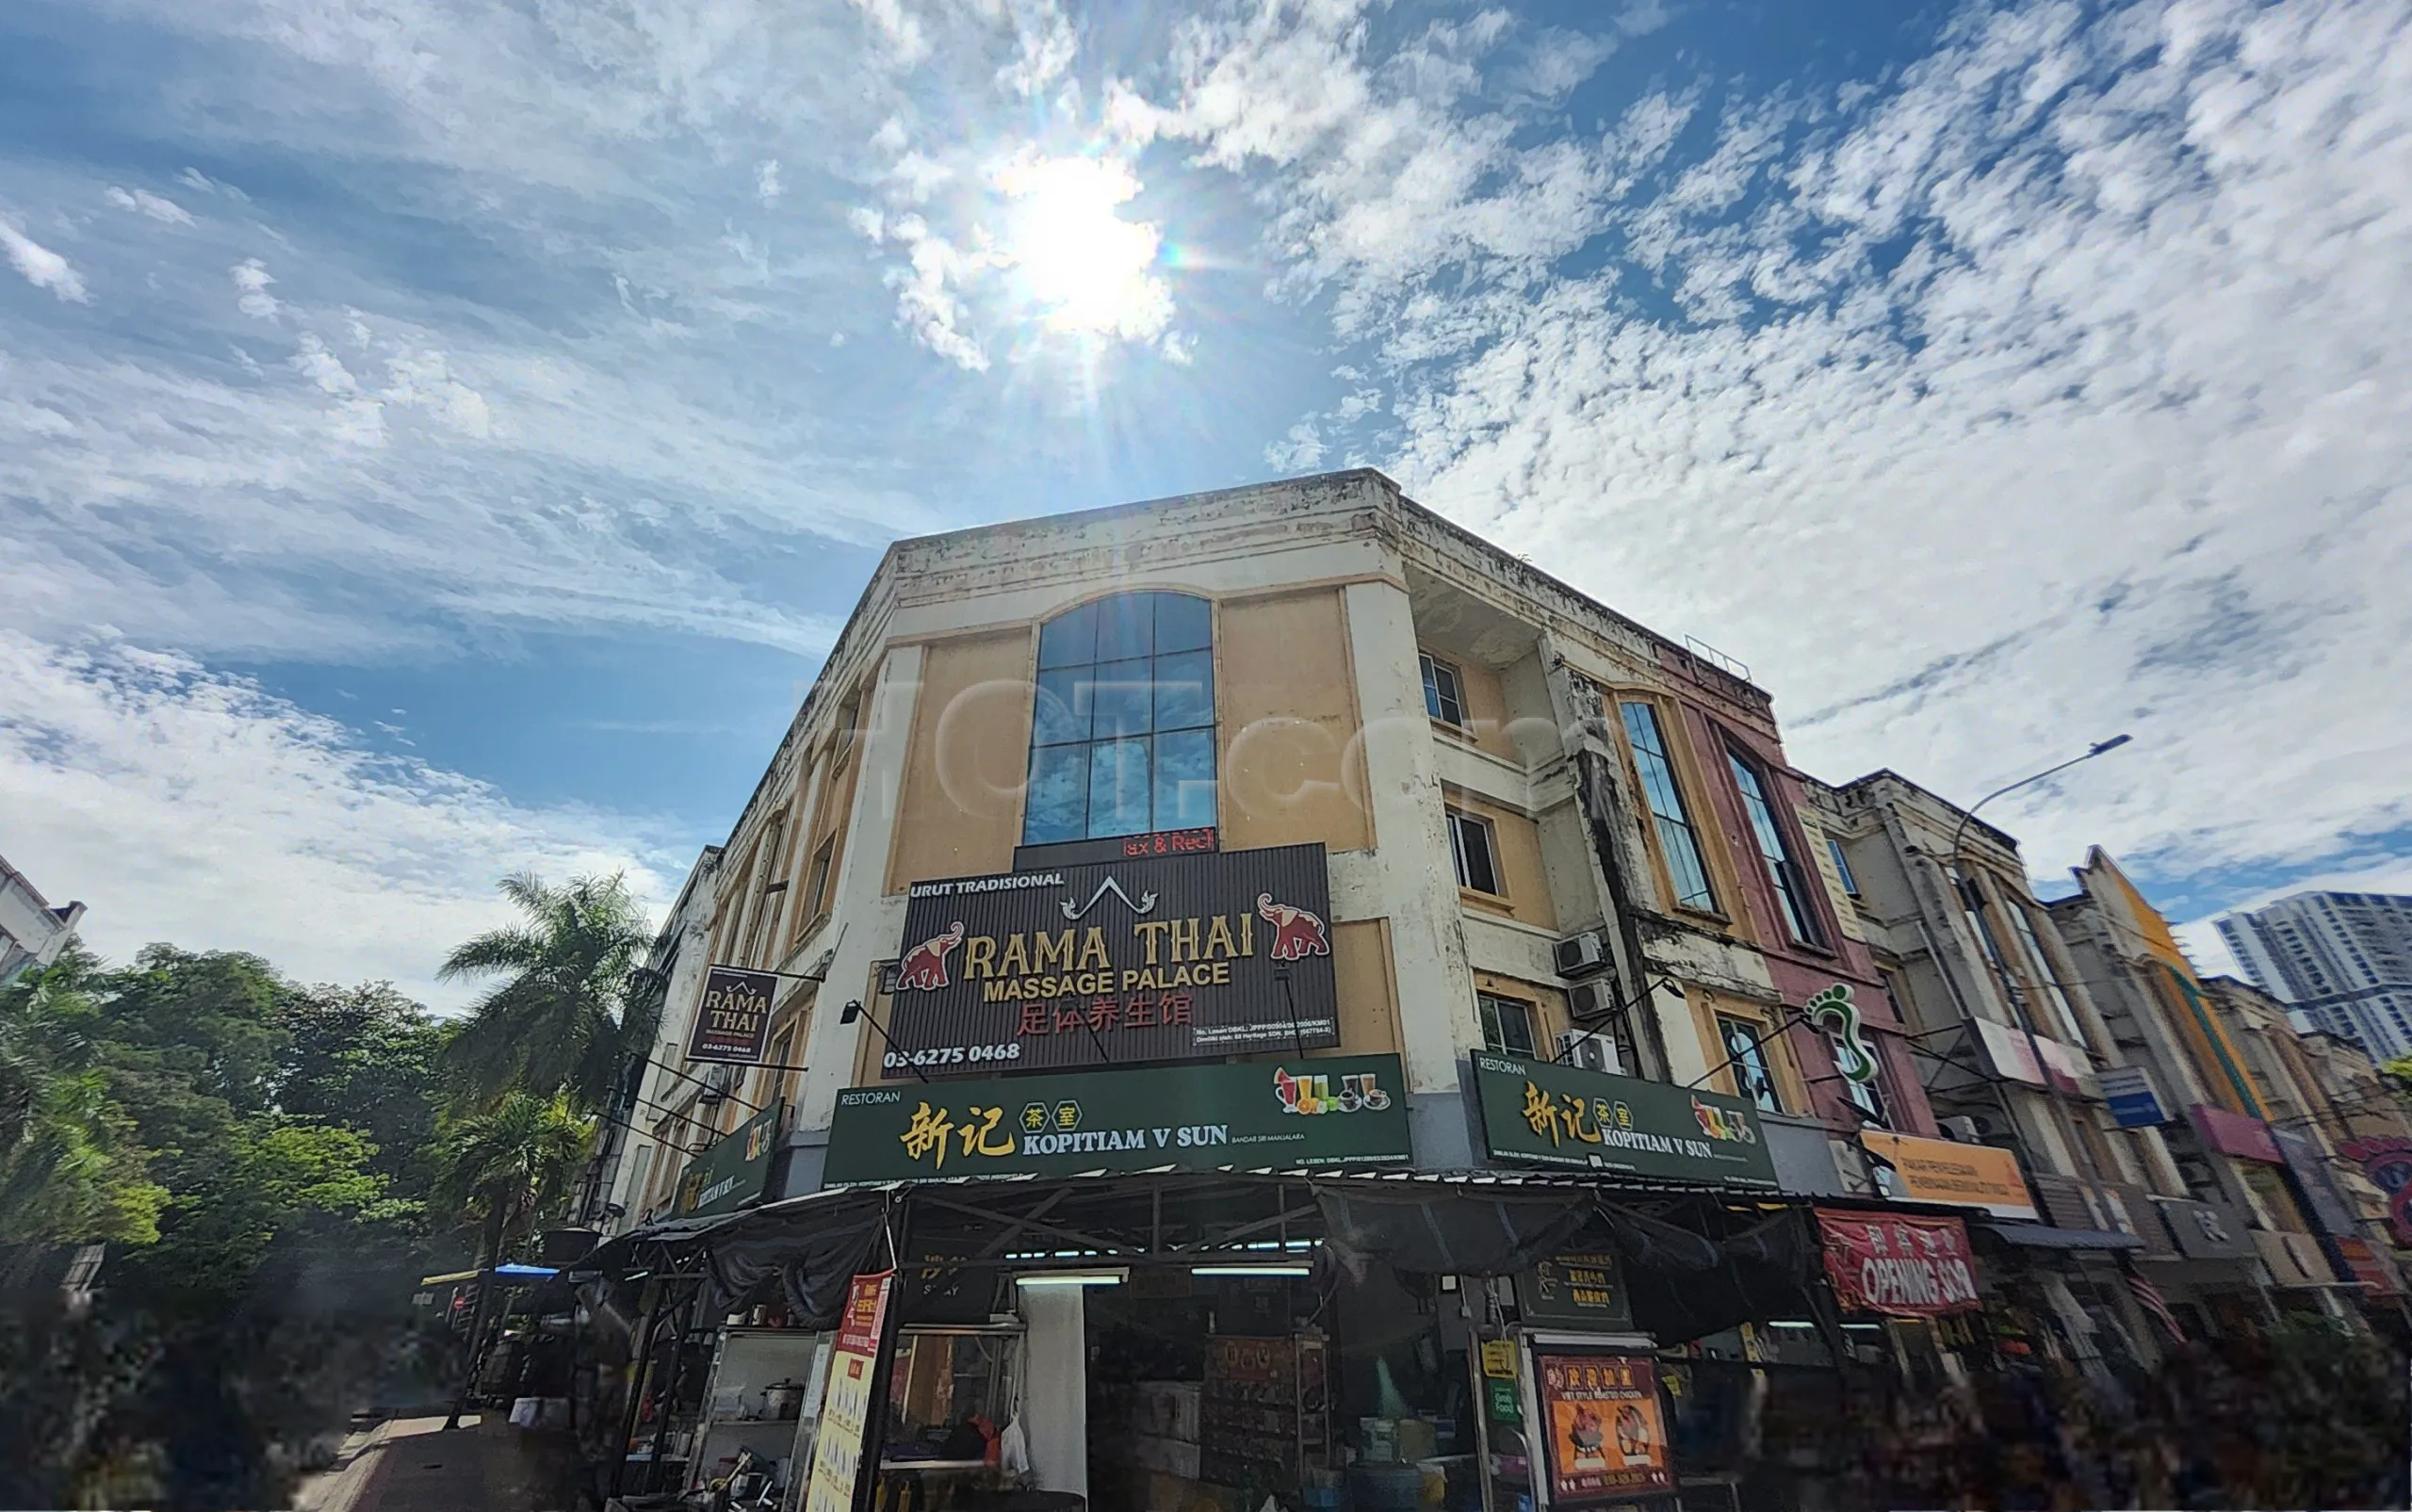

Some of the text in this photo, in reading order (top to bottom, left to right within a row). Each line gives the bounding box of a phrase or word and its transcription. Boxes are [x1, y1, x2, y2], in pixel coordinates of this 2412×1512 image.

[910, 873, 1065, 898] URUT TRADISIONAL
[963, 912, 1254, 980] RAMA THAI
[983, 962, 1230, 1002] MASSAGE PALACE
[705, 990, 767, 1015] RAMA
[1017, 993, 1194, 1036] 足体养生馆
[709, 1010, 759, 1032] THAI
[884, 1043, 1020, 1068] 03-6275 0468
[1479, 1057, 1526, 1076] RESTORAN
[840, 1091, 902, 1106] RESTORAN
[1523, 1081, 1602, 1147] 新记
[900, 1101, 1078, 1171] 新记 茶室
[1022, 1125, 1229, 1155] KOPITIAM V SUN
[1602, 1129, 1714, 1159] KOPITIAM V SUN
[1862, 1257, 1940, 1306] OPENING
[1494, 1392, 1512, 1404] Grab
[1495, 1402, 1514, 1414] Food
